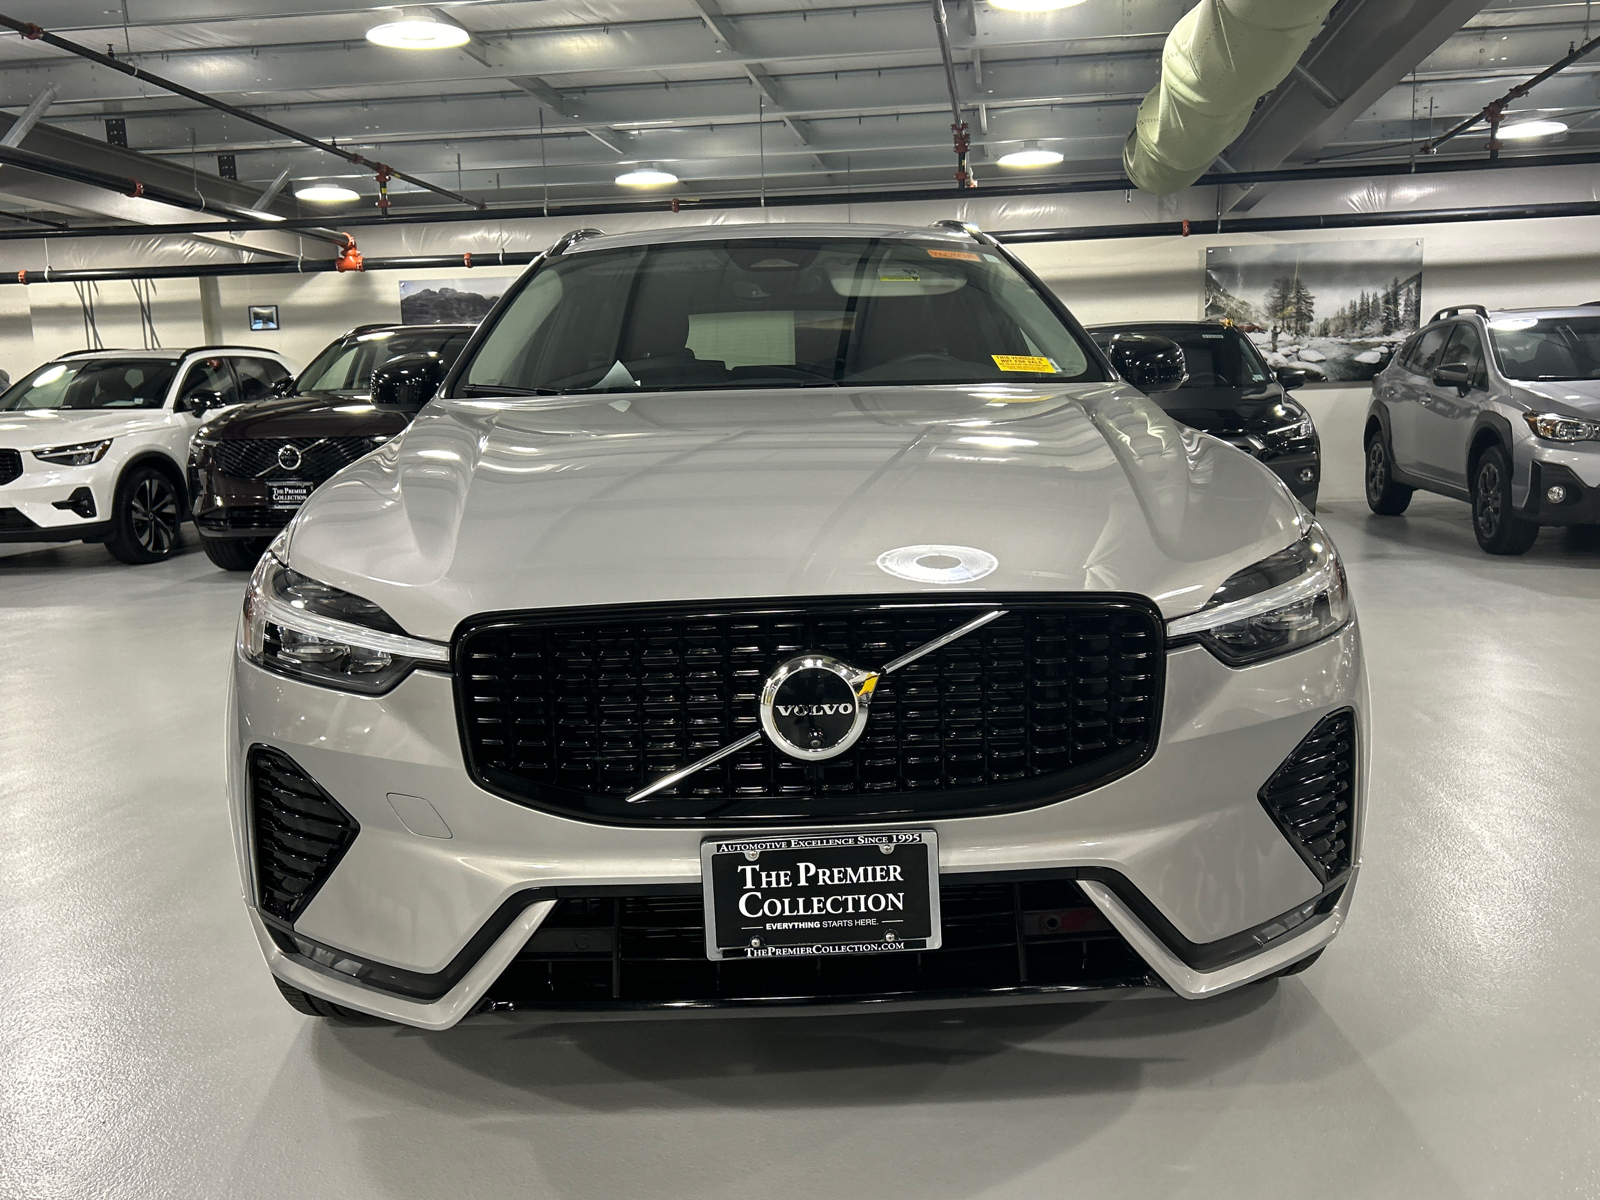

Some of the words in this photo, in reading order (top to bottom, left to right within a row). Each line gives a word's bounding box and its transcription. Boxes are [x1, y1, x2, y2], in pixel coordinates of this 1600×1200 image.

[776, 703, 853, 717] VOLVO
[719, 841, 788, 853] AUTOMOTIVE
[790, 837, 855, 848] EXCELLENCE
[857, 835, 889, 845] SINCE
[892, 833, 921, 843] 1995
[737, 864, 793, 889] THE
[796, 862, 905, 886] PREMIER
[738, 892, 905, 918] COLLECTION
[765, 921, 821, 931] EVERYTHING
[822, 919, 853, 928] STARTS
[854, 918, 880, 926] HERE.
[744, 942, 905, 957] THEPREMIERCOLLECTION.COM
